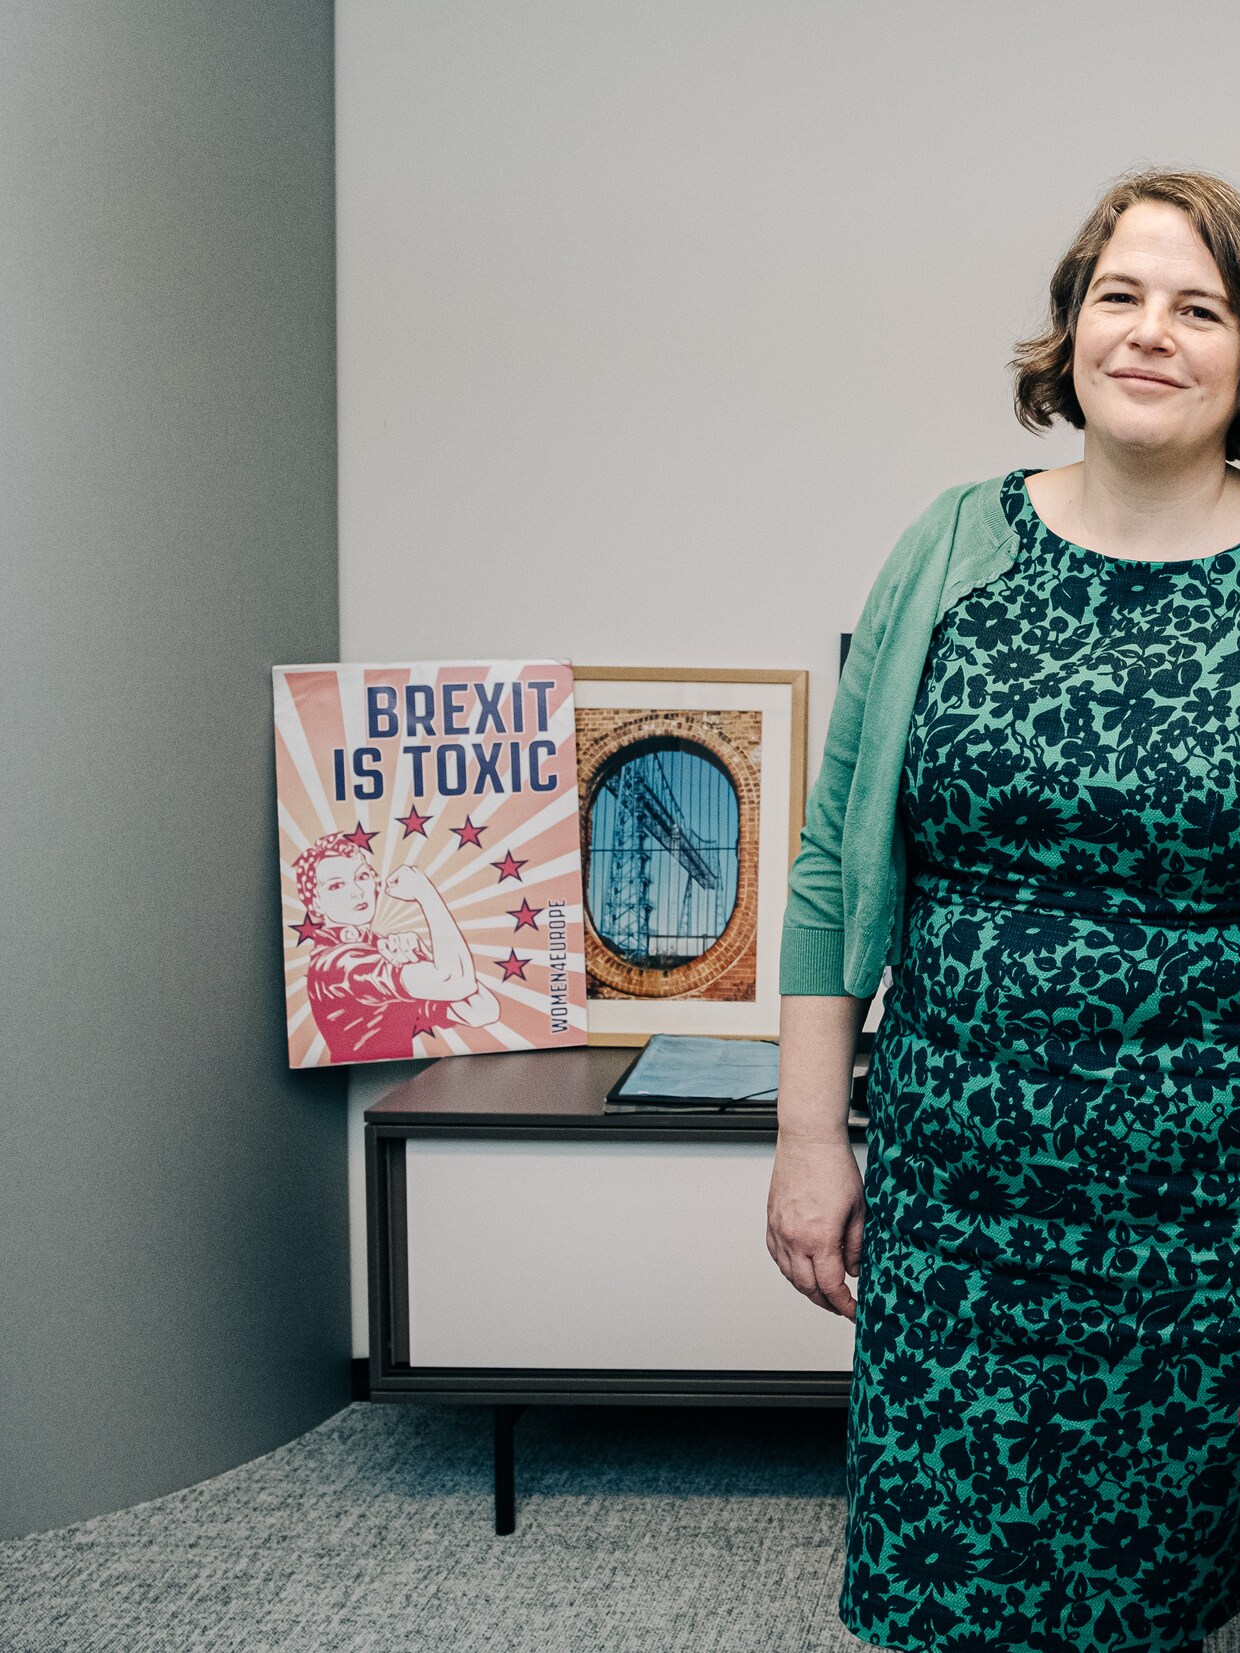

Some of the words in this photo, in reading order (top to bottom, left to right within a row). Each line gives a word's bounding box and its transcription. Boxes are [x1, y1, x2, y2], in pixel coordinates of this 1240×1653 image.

[367, 681, 556, 739] BREXIT
[333, 746, 385, 801] IS
[403, 740, 558, 798] TOXIC
[548, 899, 568, 1034] WOMEN4EUROPE
